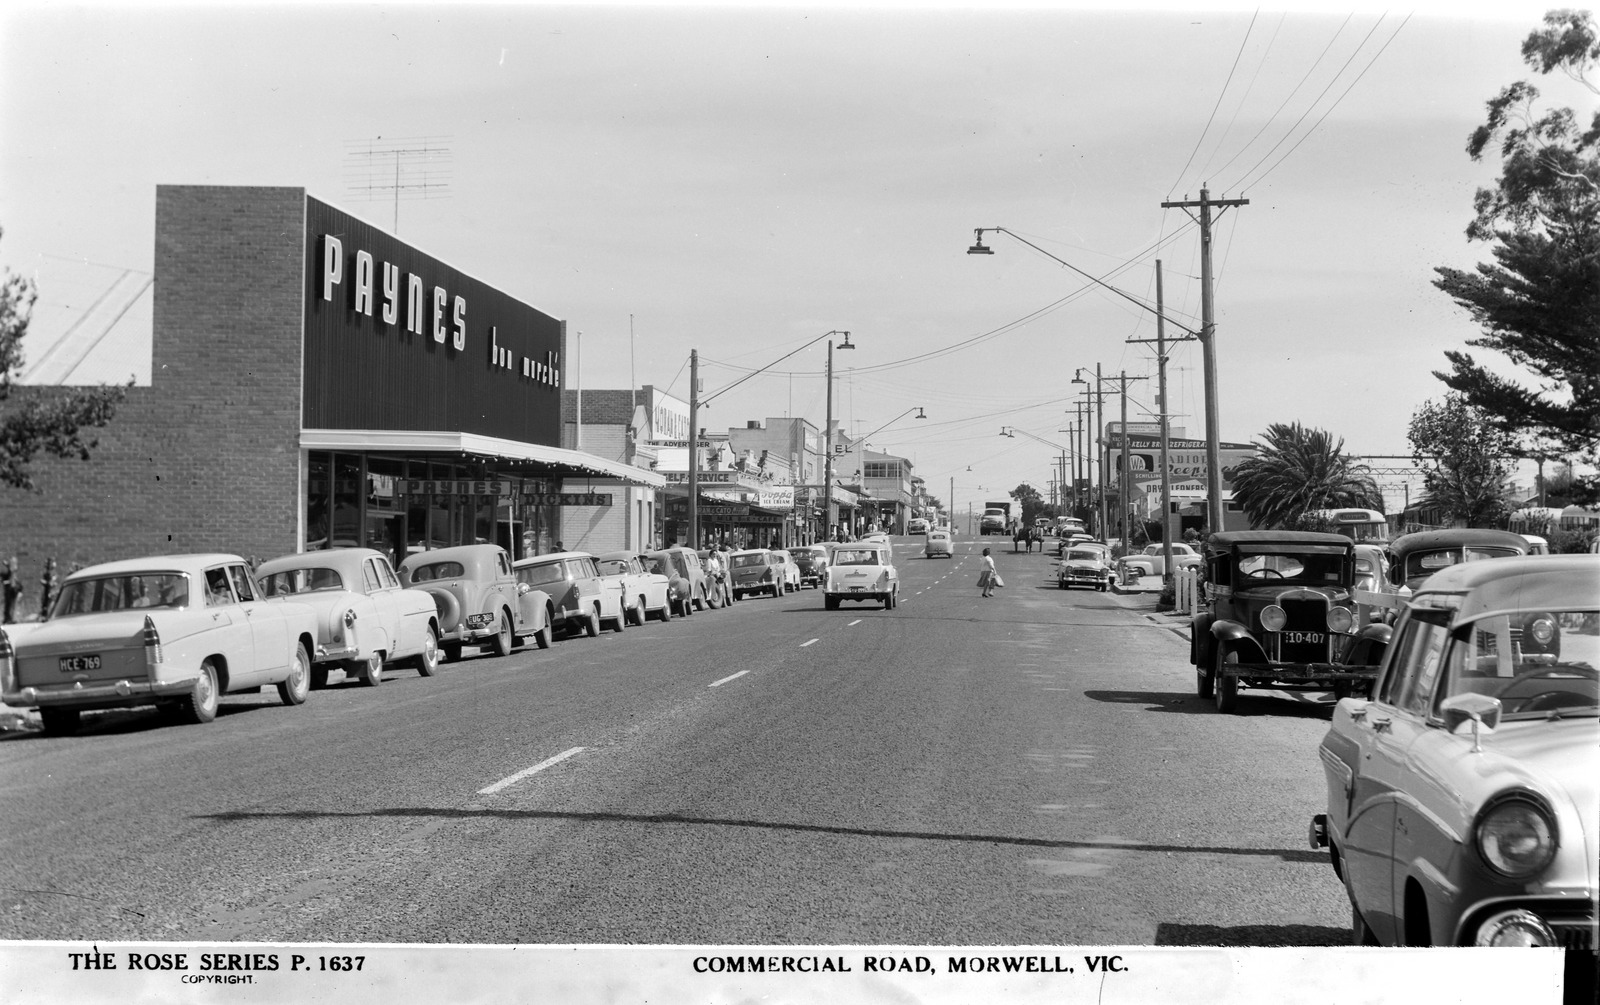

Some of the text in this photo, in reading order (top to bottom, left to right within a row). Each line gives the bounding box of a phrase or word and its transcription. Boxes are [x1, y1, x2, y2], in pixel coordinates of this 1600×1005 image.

[324, 233, 466, 351] PAYNES
[493, 326, 512, 370] bon
[692, 473, 729, 482] ERVICE
[406, 480, 503, 494] PAYNES
[1146, 484, 1162, 493] DRY
[715, 506, 732, 514] CATO
